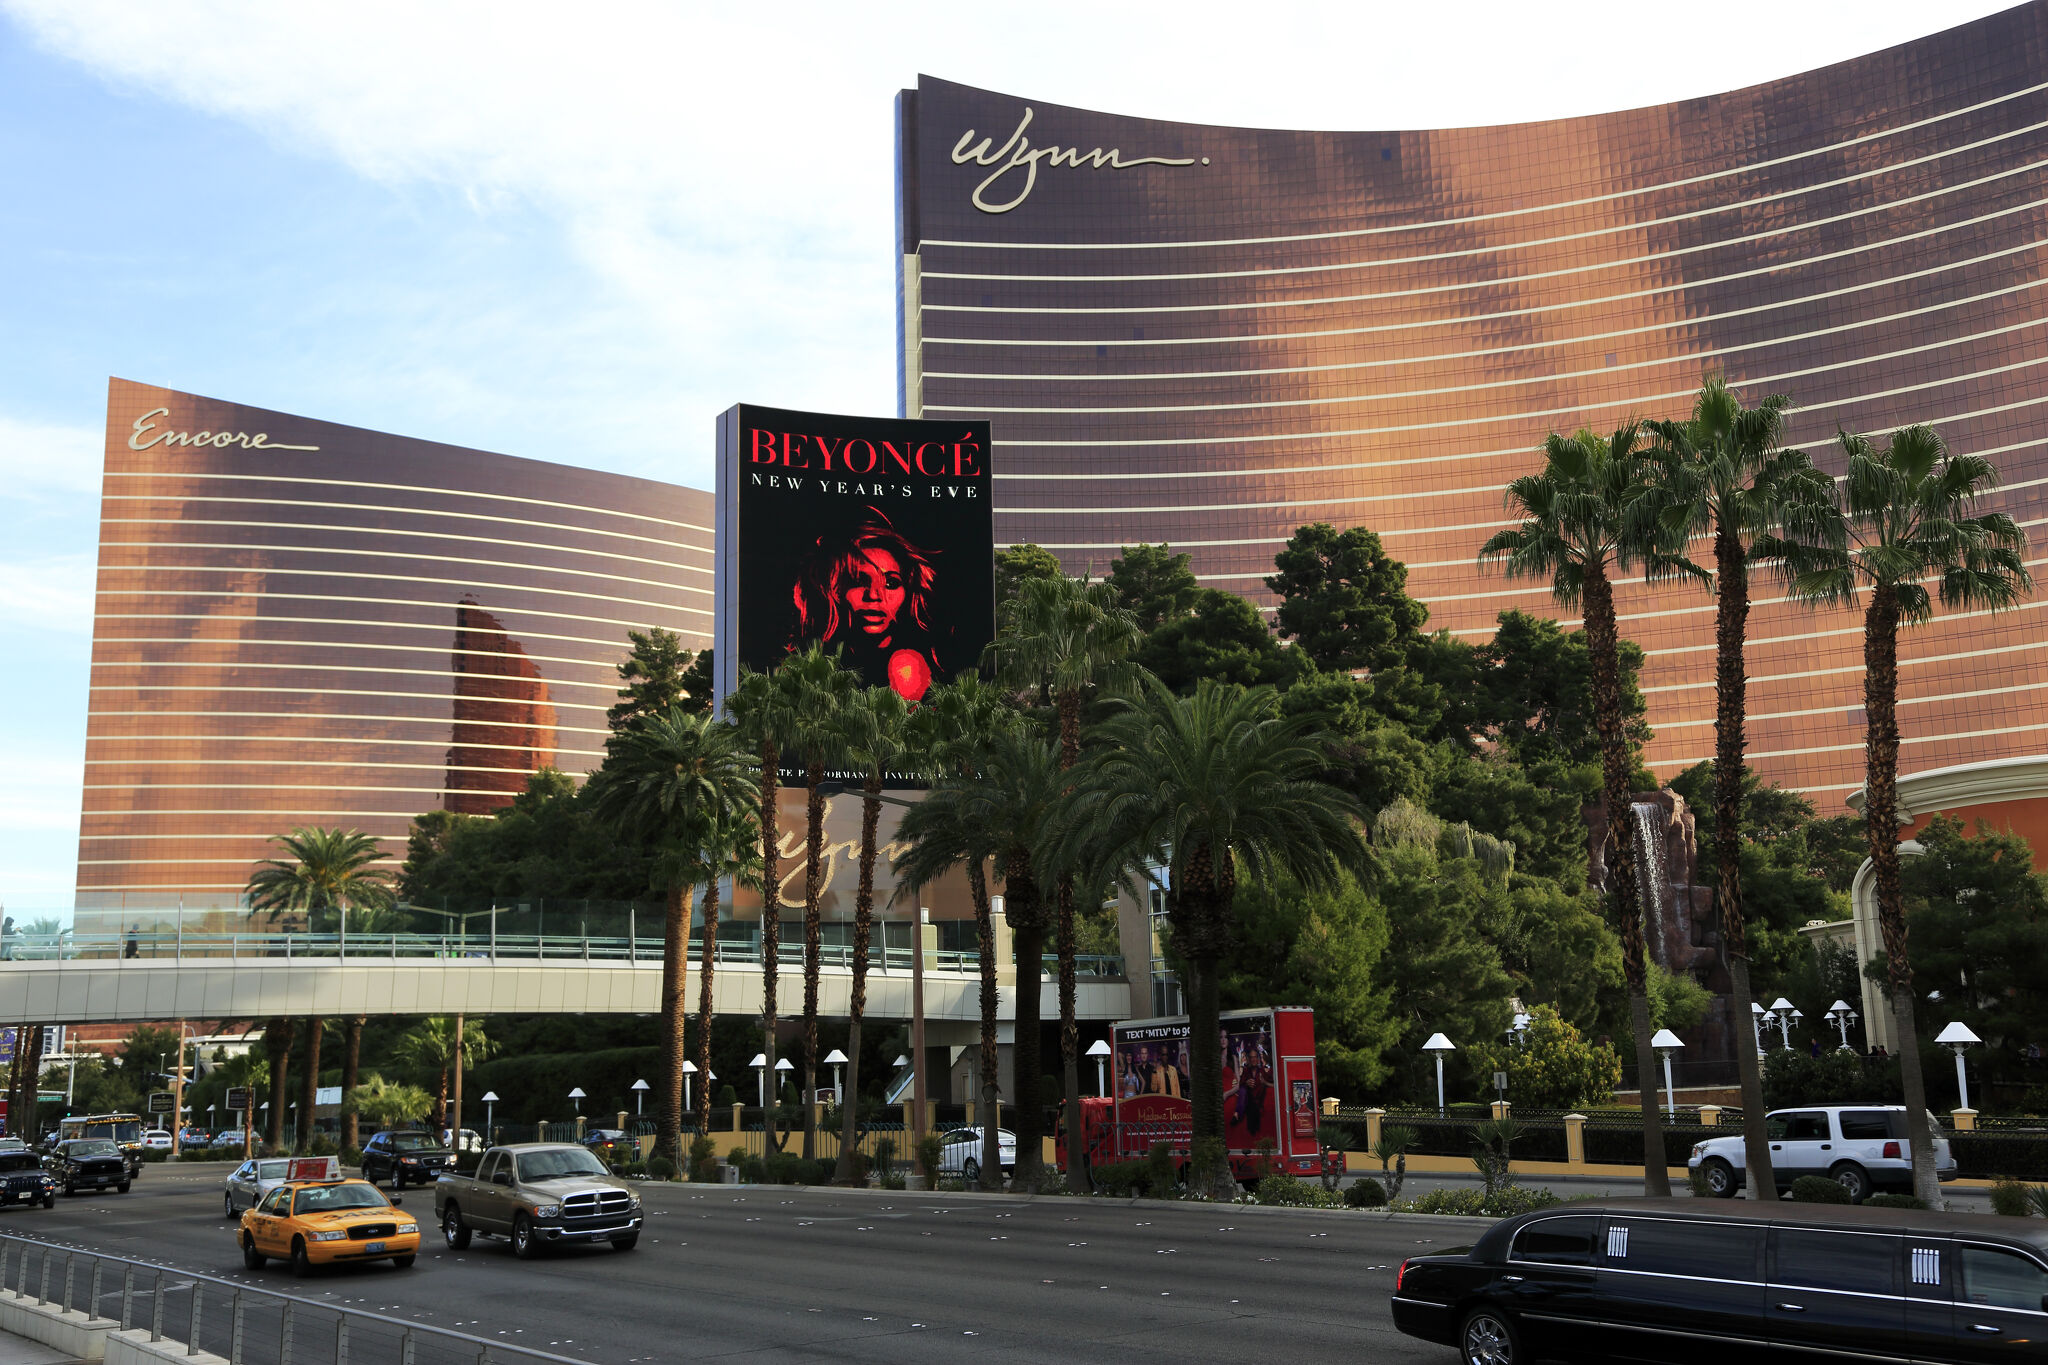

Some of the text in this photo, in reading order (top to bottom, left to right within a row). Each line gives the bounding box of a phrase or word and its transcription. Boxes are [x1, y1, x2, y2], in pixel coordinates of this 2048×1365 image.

[128, 407, 320, 451] Encore
[748, 428, 981, 477] BEYONCÉ
[752, 473, 977, 498] NEW YEAR'S EVE
[1126, 1030, 1145, 1039] TEXT
[1173, 1027, 1181, 1036] to
